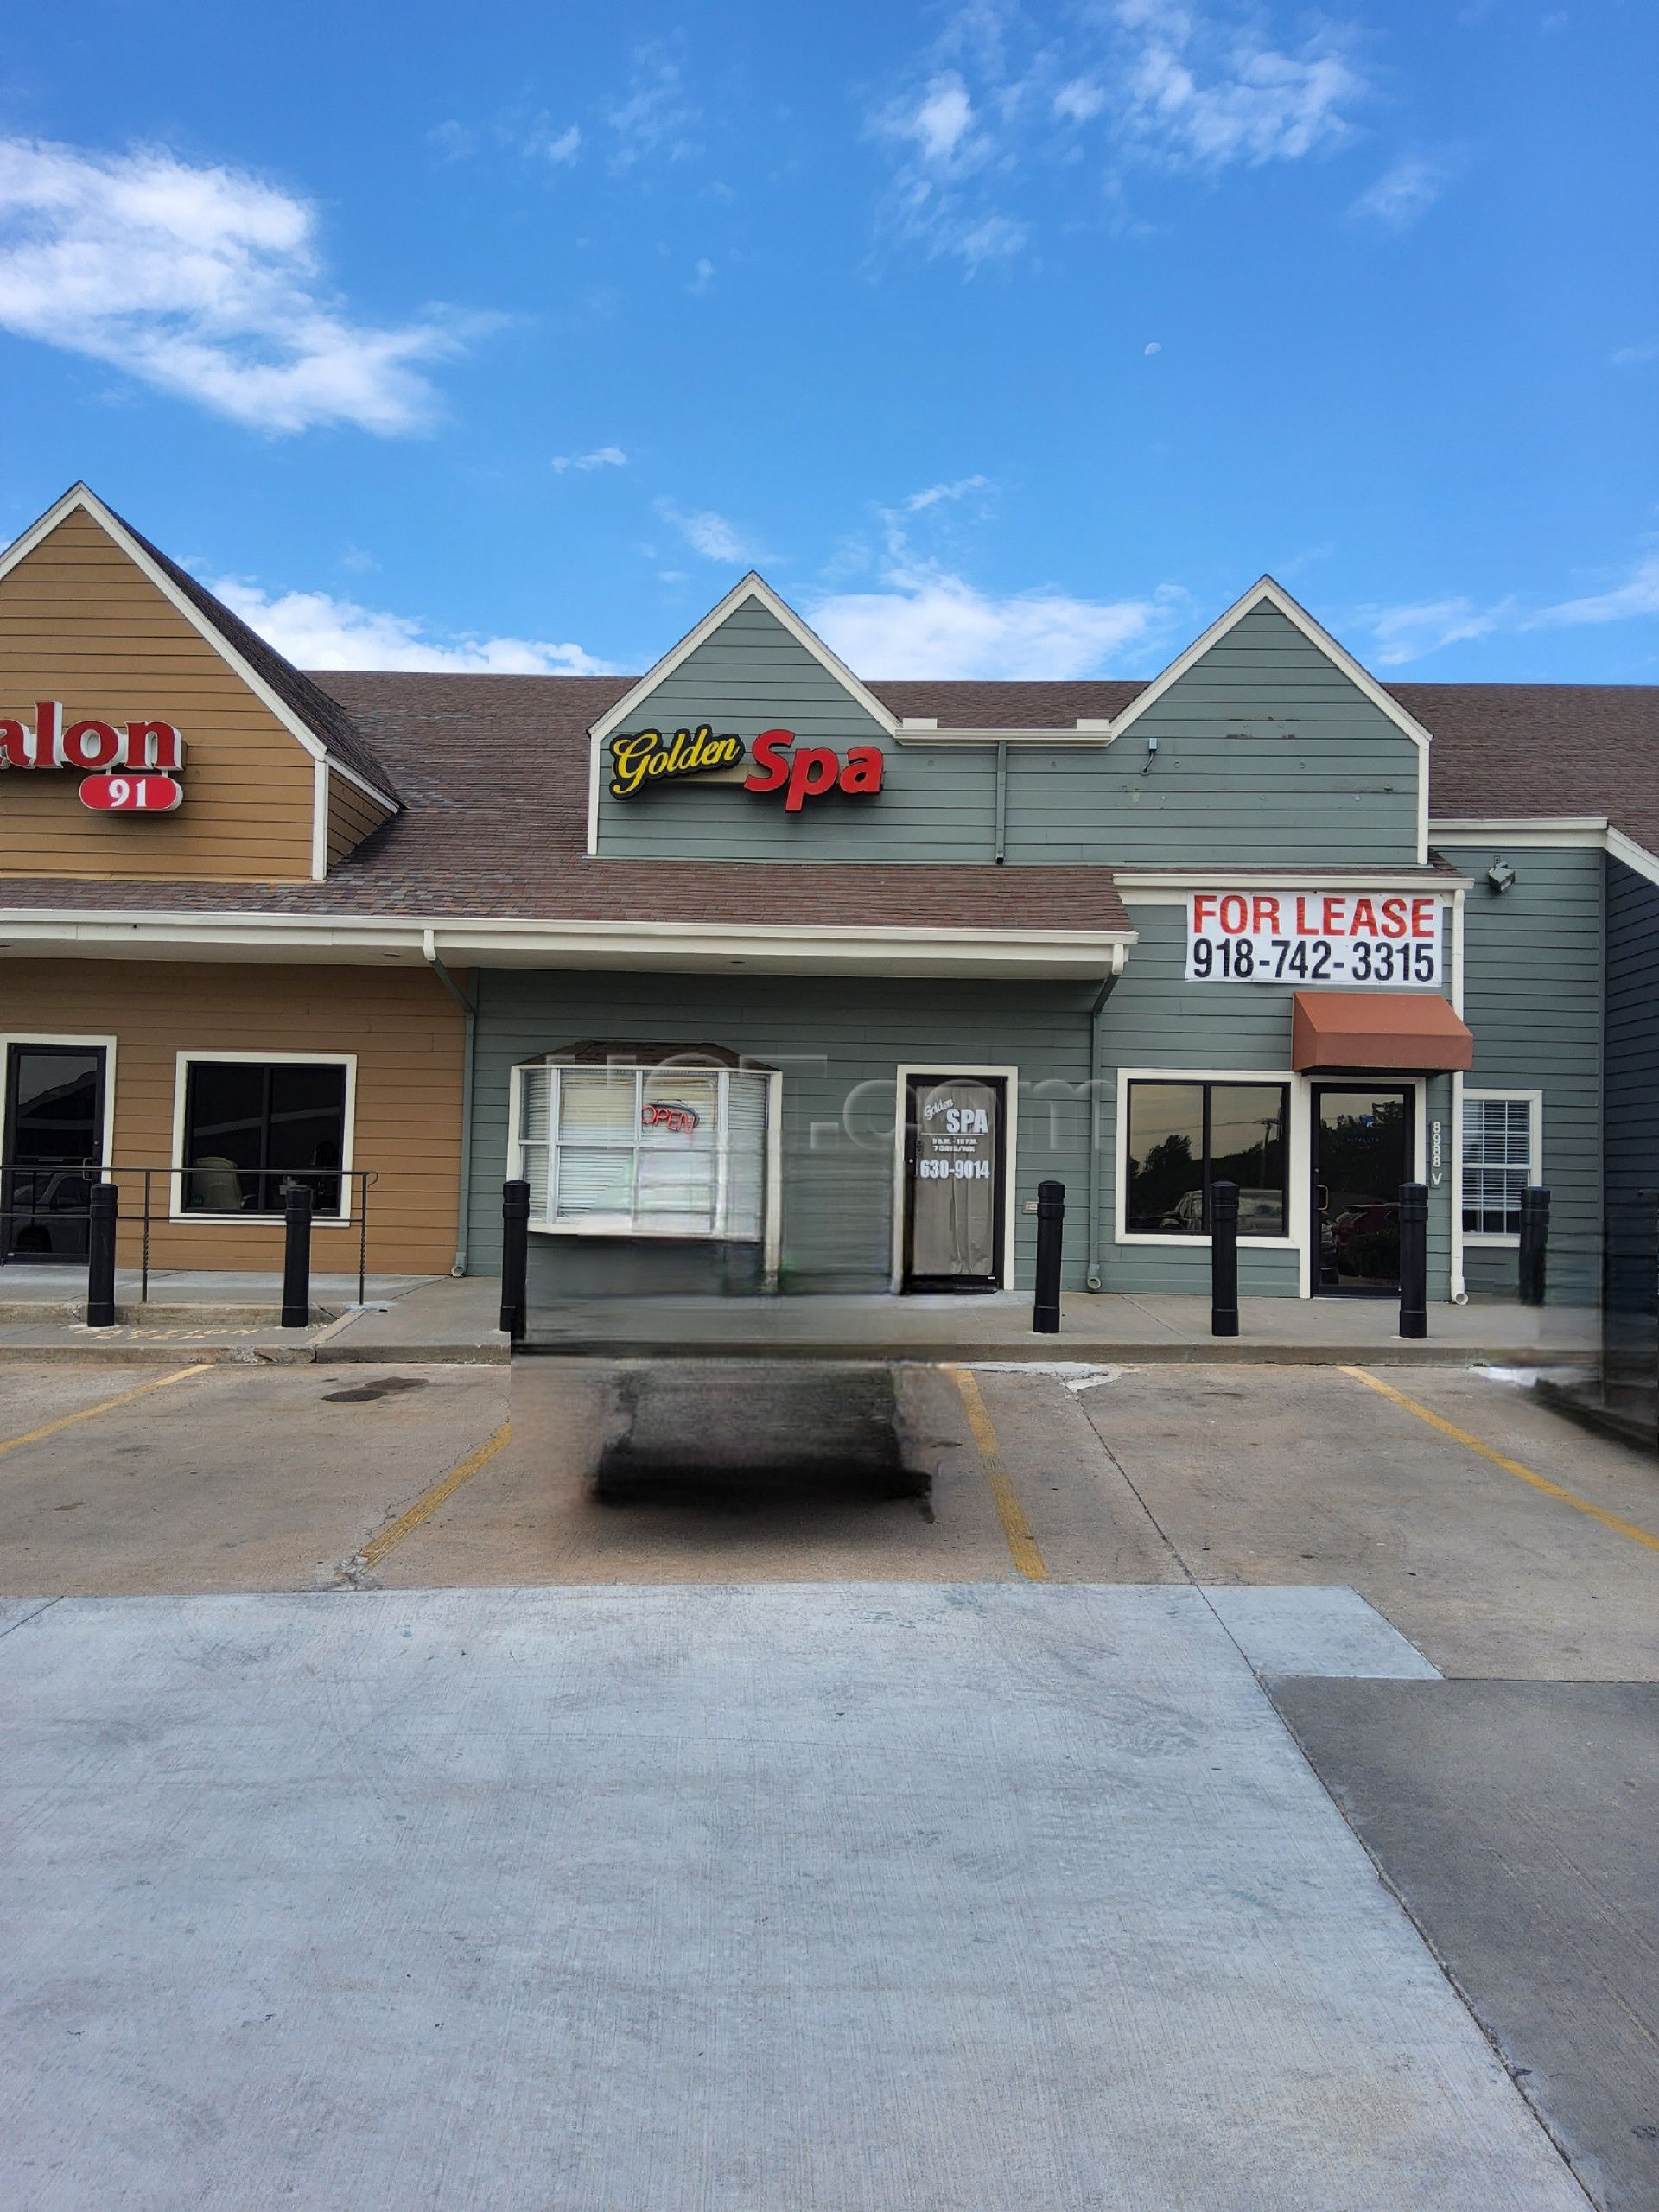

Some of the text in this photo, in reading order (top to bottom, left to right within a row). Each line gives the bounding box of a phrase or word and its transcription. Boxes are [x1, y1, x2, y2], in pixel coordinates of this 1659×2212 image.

[611, 724, 884, 814] Golden Spa
[108, 778, 148, 809] 91
[1193, 894, 1435, 938] FOR LEASE
[1193, 938, 1435, 982] 918-742-3315
[639, 1104, 695, 1135] OPEN
[924, 1098, 954, 1120] Golden
[946, 1109, 988, 1134] SPA
[920, 1159, 990, 1179] 630-9014
